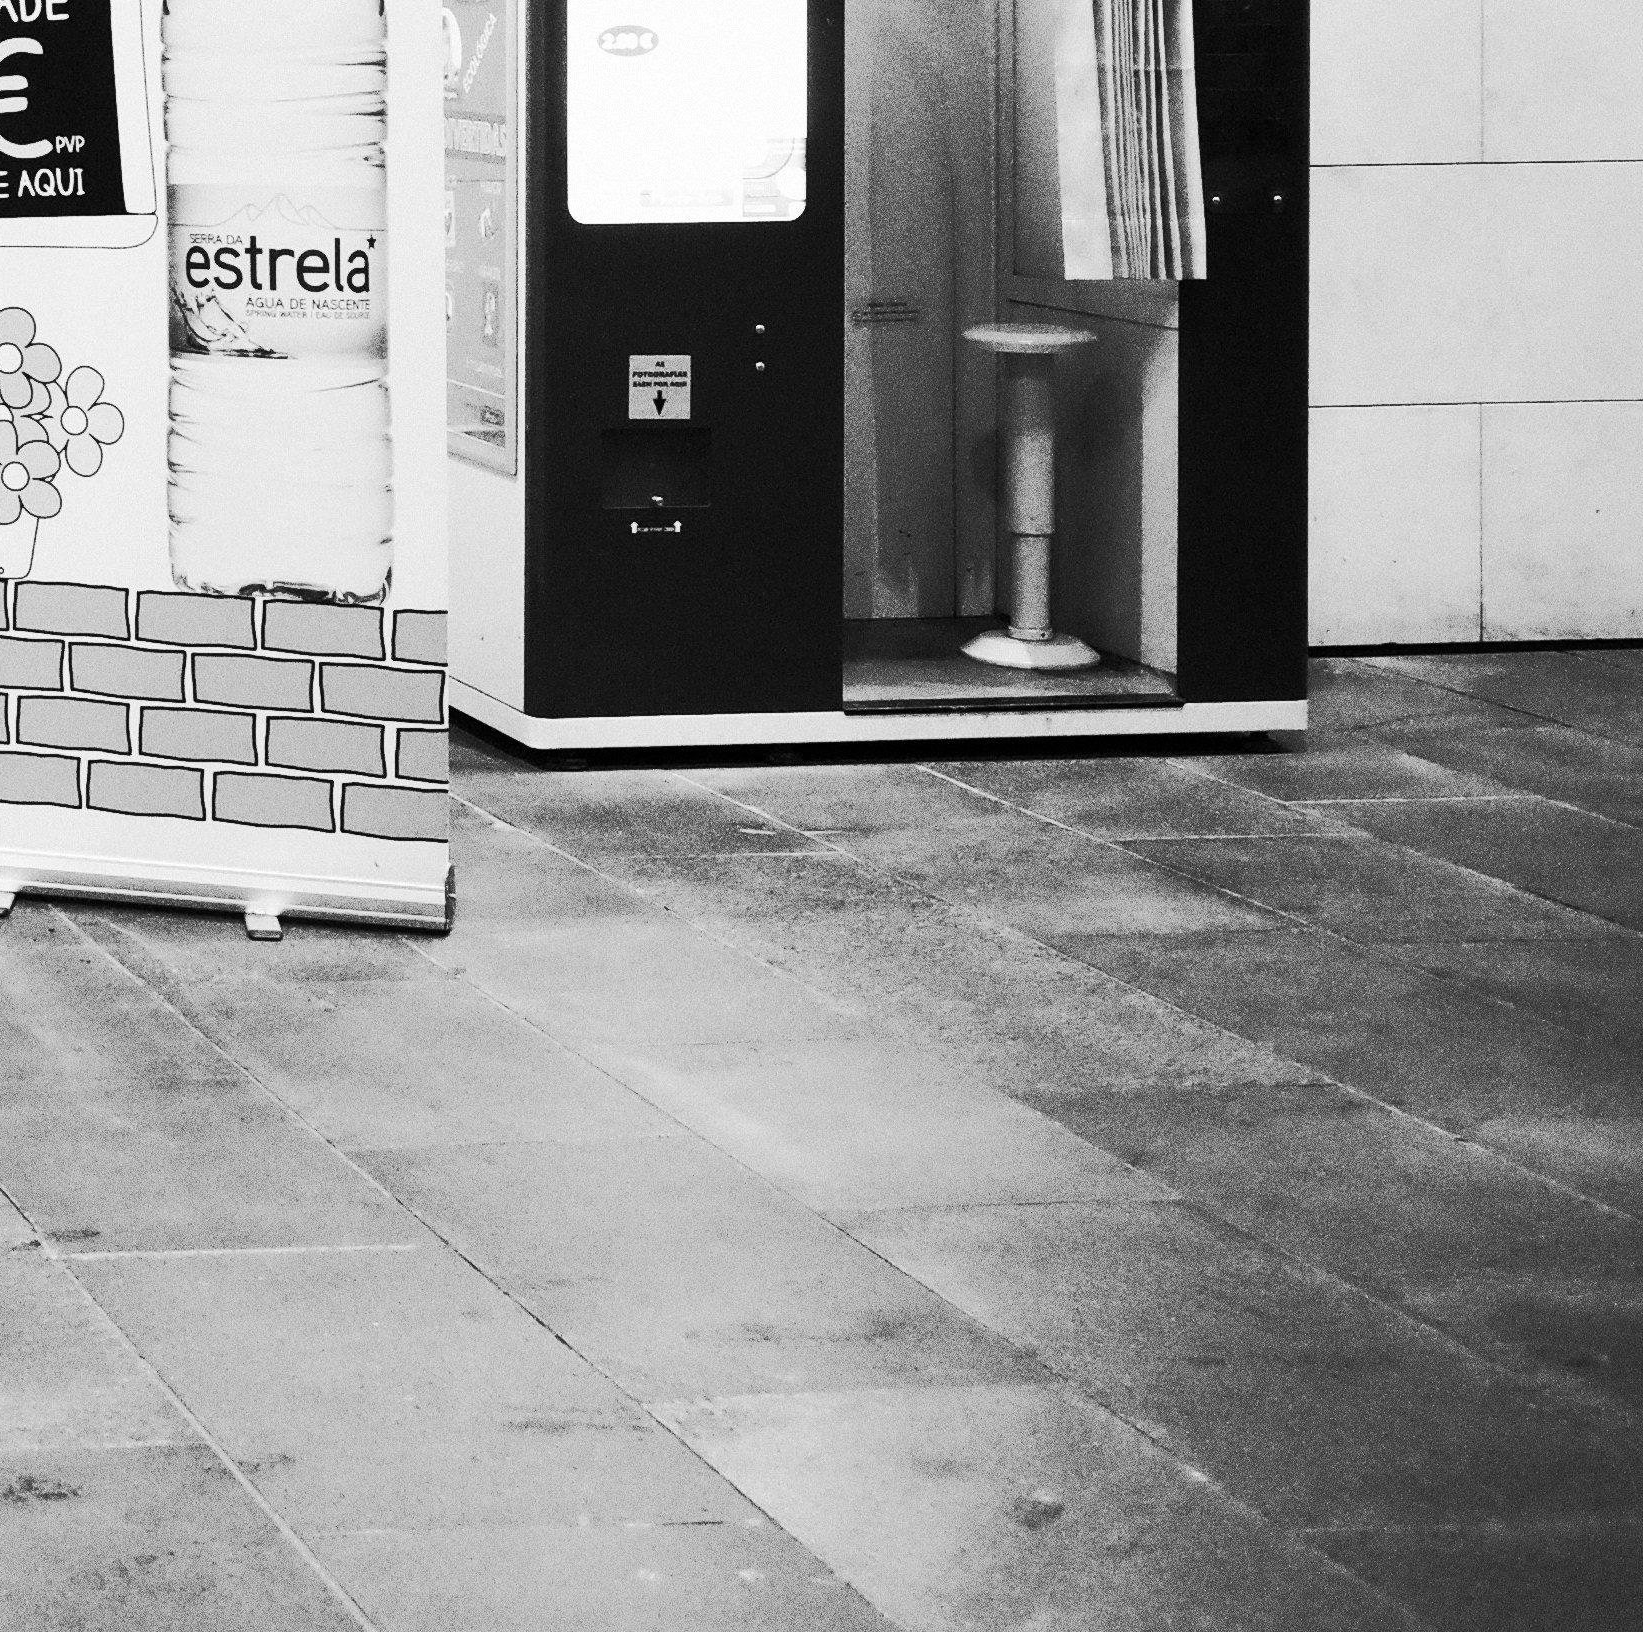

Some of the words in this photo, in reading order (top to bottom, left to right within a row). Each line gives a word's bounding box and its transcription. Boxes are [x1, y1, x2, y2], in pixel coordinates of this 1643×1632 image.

[55, 134, 86, 154] PVP
[17, 167, 86, 198] AQUI
[189, 233, 223, 245] SERRA
[226, 234, 244, 245] DA
[185, 235, 371, 294] estrela
[289, 298, 307, 310] DE
[311, 298, 371, 311] NASCENTE
